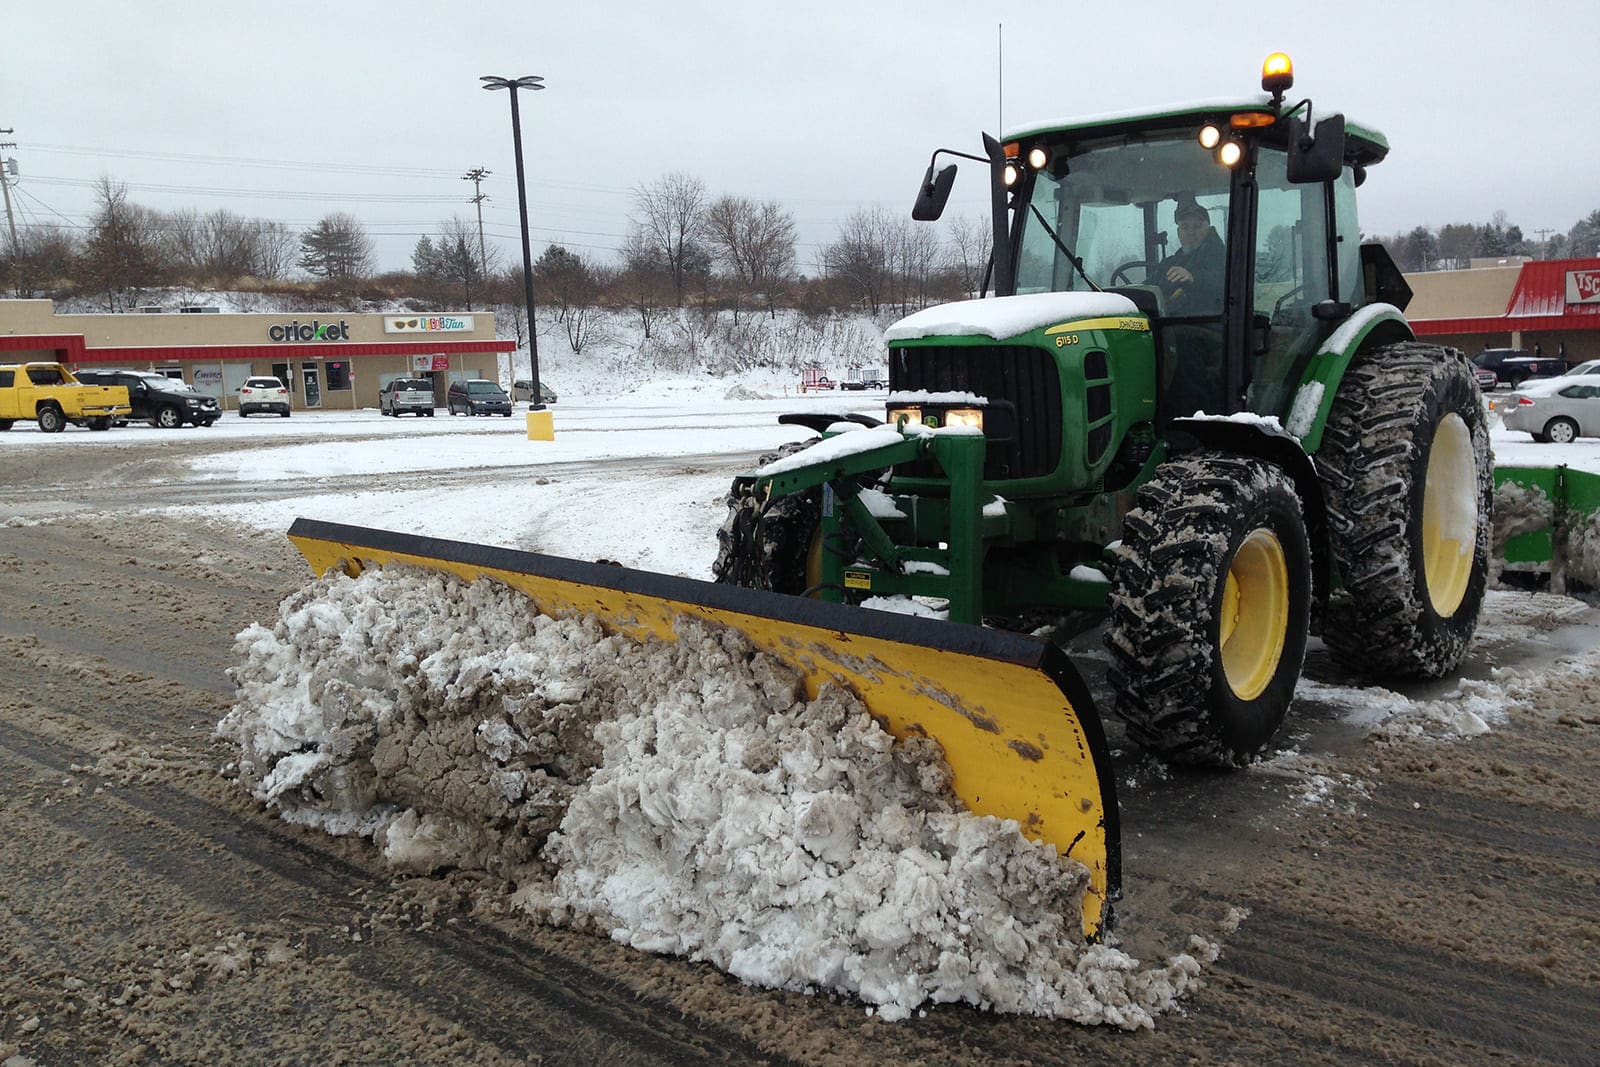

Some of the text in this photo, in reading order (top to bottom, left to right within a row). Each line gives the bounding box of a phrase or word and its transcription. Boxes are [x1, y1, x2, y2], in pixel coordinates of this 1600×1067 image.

[1577, 273, 1600, 294] TSC
[268, 320, 349, 341] cricket
[446, 318, 465, 329] Tan
